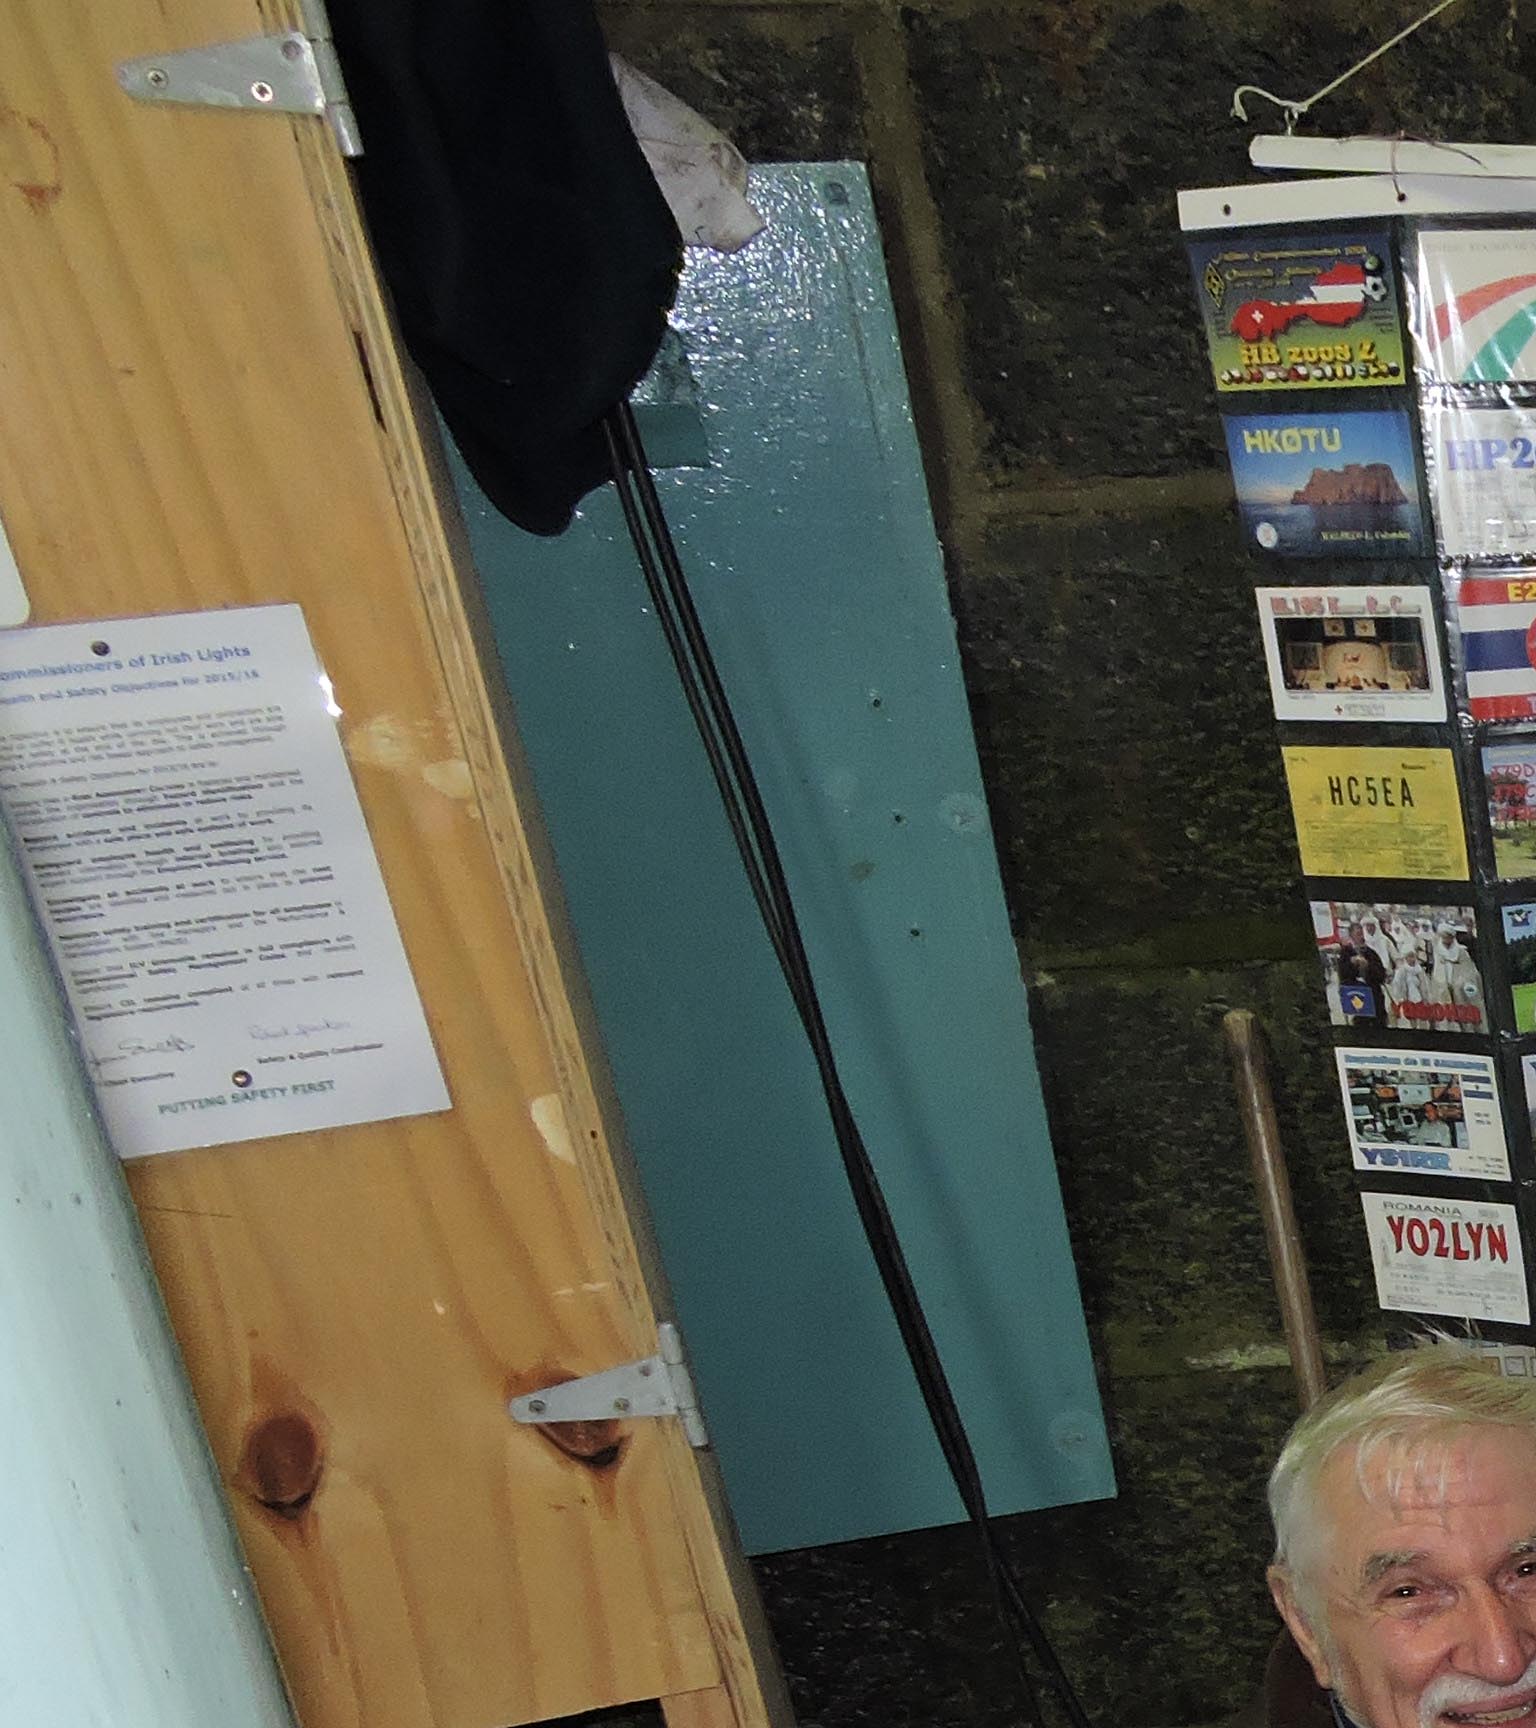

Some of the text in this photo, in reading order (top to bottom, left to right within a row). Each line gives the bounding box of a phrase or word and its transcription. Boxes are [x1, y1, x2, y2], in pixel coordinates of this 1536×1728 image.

[197, 645, 251, 664] Lights
[1329, 776, 1415, 809] HC5EA
[158, 1079, 335, 1115] PUTTING SAFETY FIRST
[1383, 1201, 1462, 1216] ROMANIA
[1386, 1215, 1509, 1264] YO2LYN
